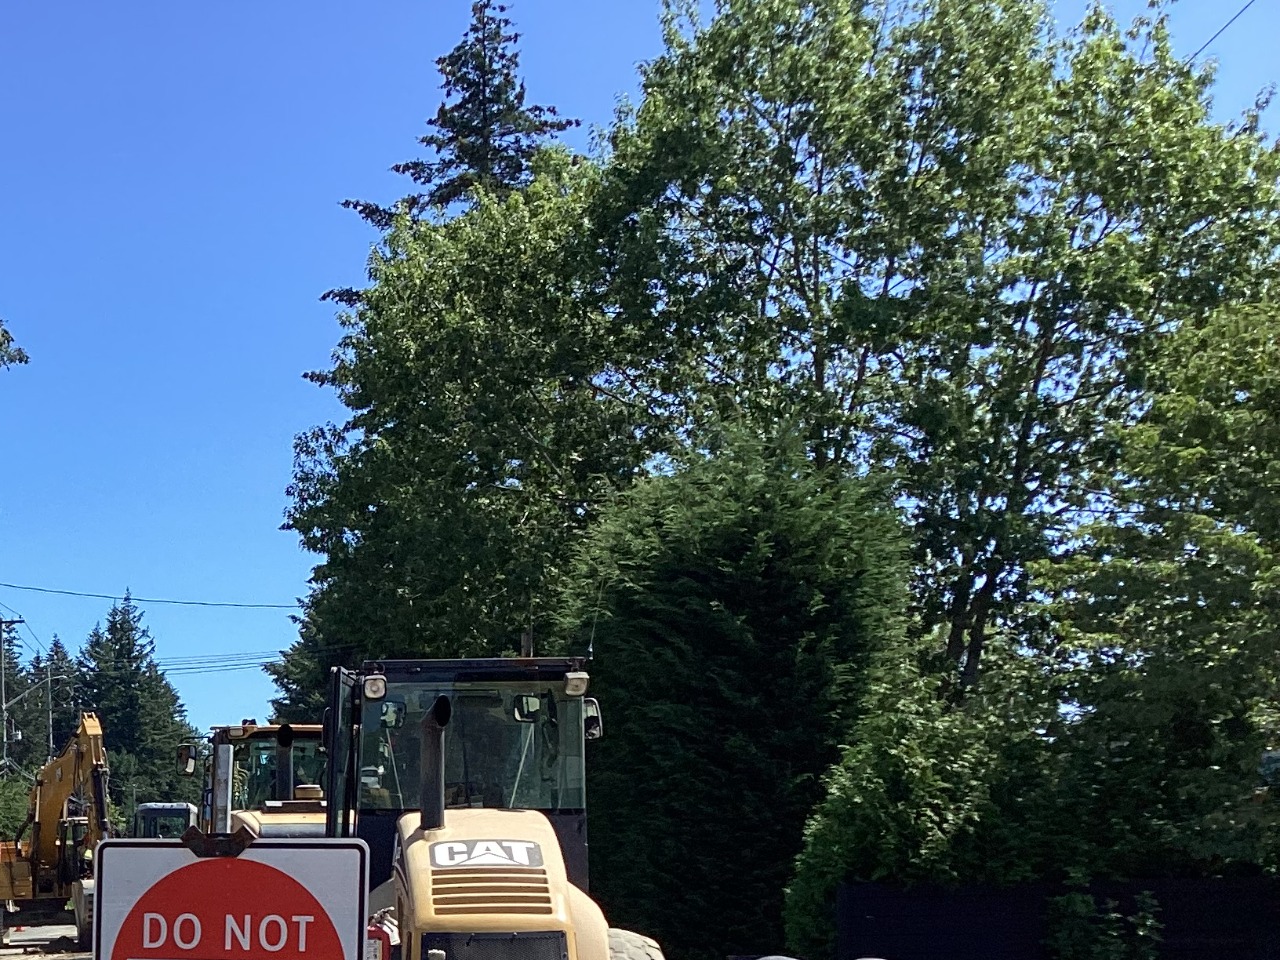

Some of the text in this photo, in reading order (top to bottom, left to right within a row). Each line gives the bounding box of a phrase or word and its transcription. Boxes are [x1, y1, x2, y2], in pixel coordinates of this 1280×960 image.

[434, 840, 536, 866] CAT
[142, 912, 315, 952] DO NOT
